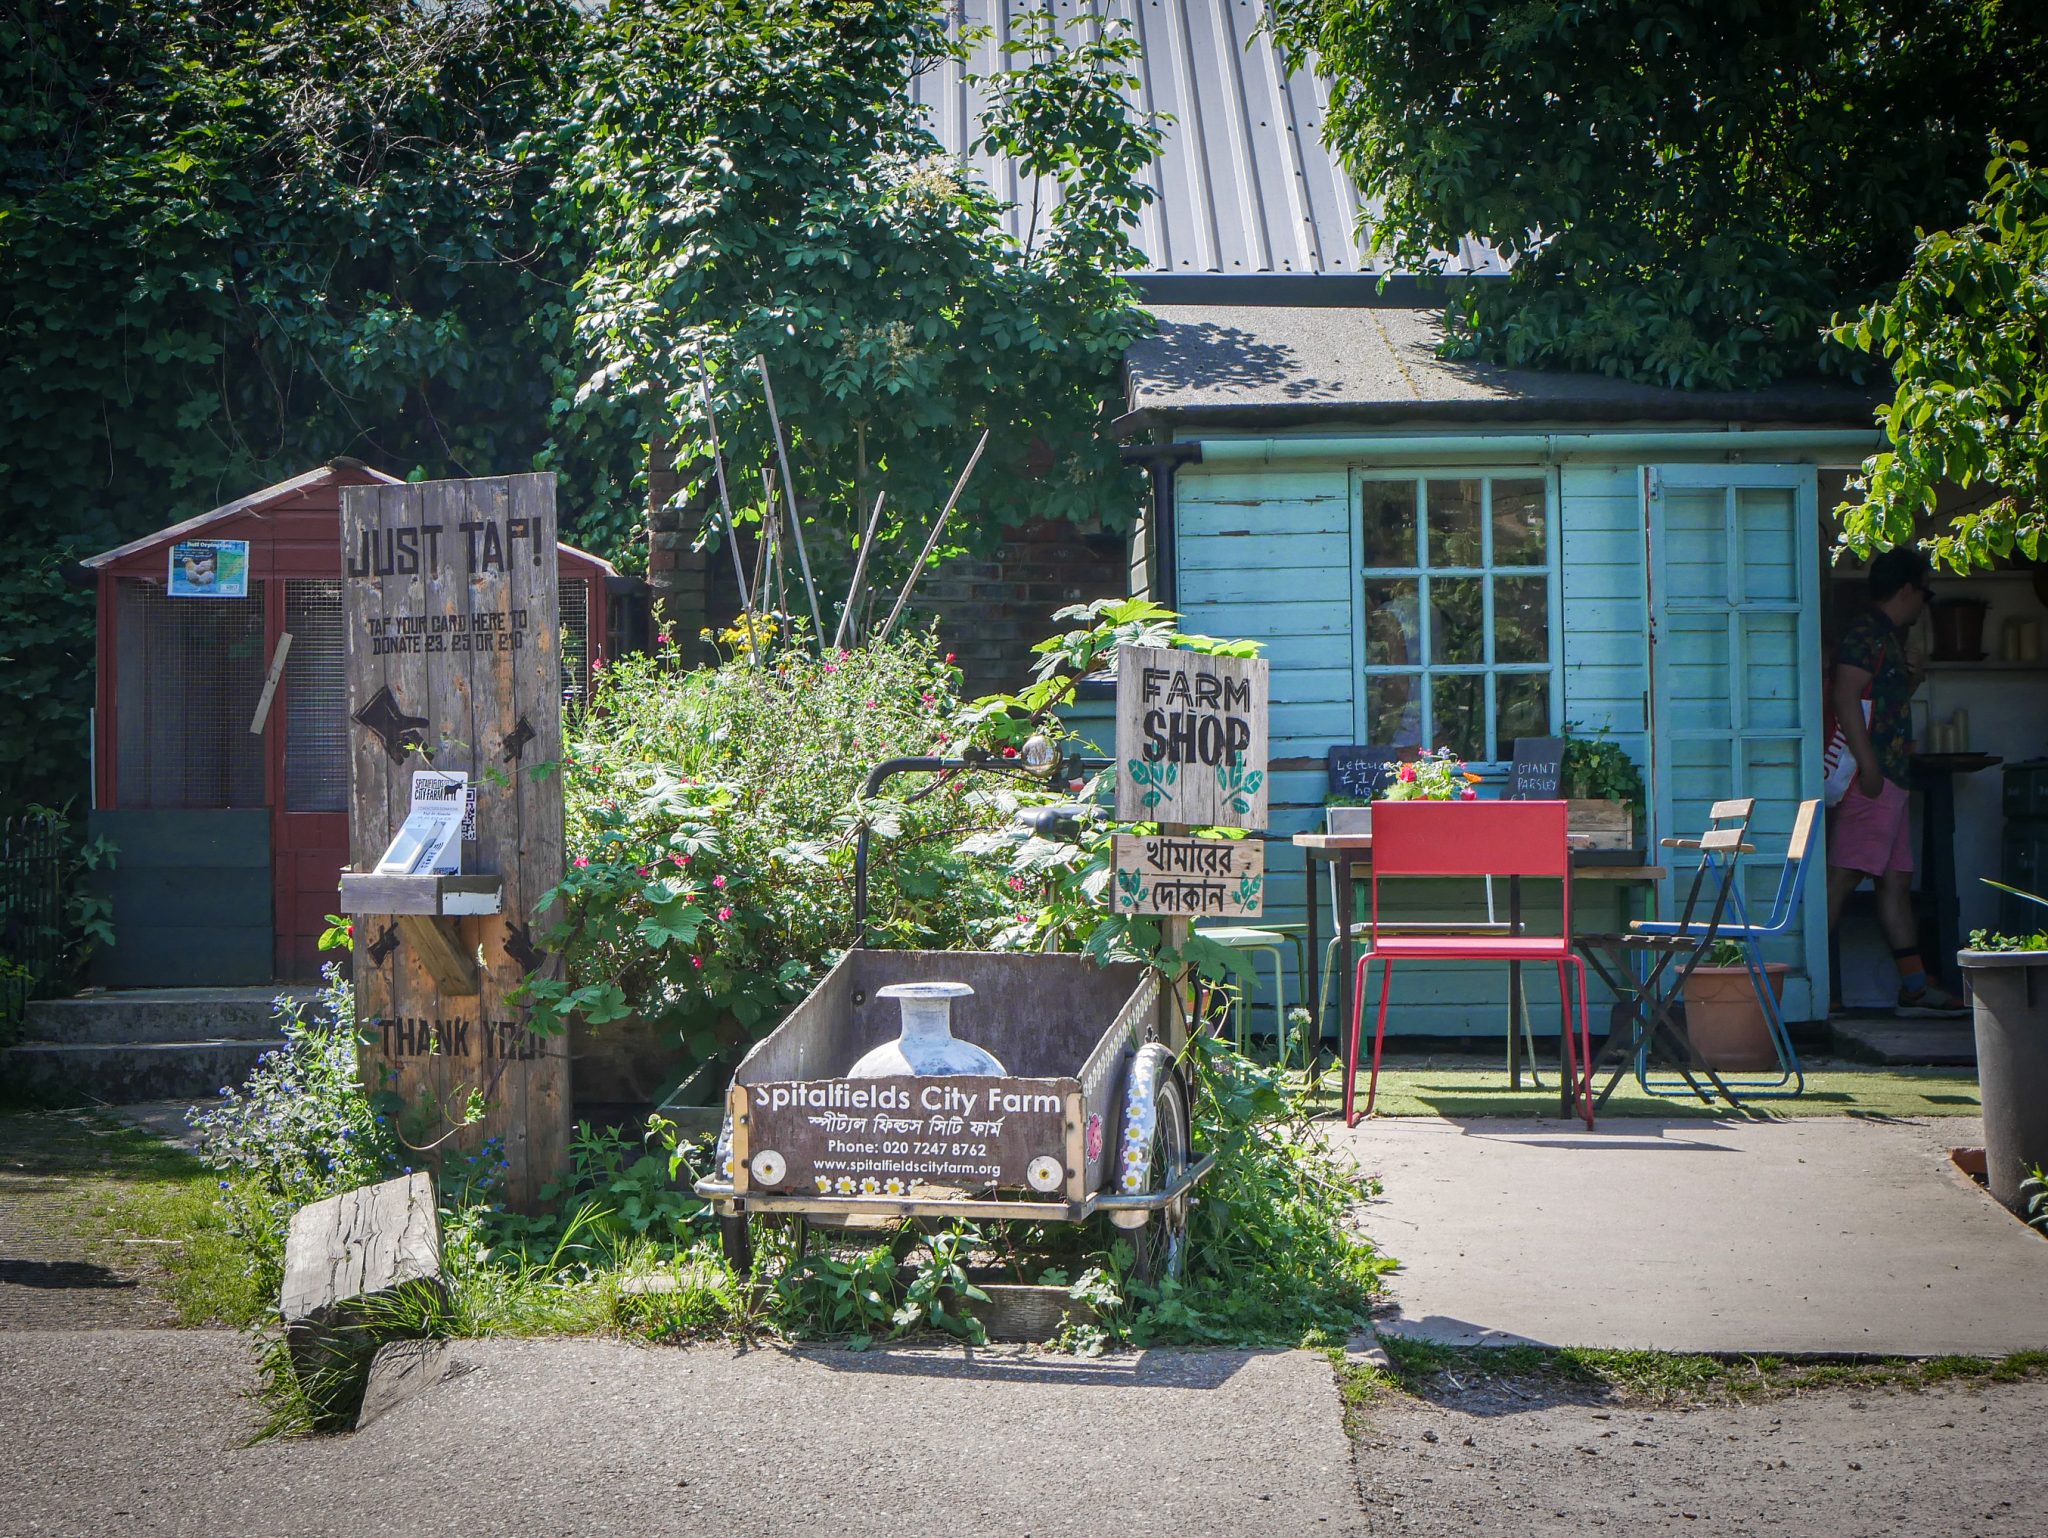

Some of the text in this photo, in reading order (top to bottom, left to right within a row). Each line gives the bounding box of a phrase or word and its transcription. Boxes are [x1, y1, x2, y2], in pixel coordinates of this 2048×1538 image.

[348, 517, 542, 578] JUST TAP!
[368, 610, 527, 636] TAP YOUR CARD HERE TO
[373, 636, 420, 655] DONATE
[452, 634, 471, 651] £5
[476, 633, 493, 651] OR
[1142, 668, 1250, 713] FARM
[1142, 707, 1251, 767] SHOP
[1517, 777, 1556, 791] PARSLEY
[1518, 763, 1557, 775] GIANT
[1147, 838, 1234, 876] খামারের
[1152, 879, 1226, 913] দোকান
[379, 1016, 469, 1057] THANK
[756, 1082, 1061, 1116] Spitalfields City Farm
[928, 1115, 964, 1137] সিটি
[970, 1116, 1005, 1138] ফার্ম
[828, 1140, 986, 1157] Phone: 020 7247 8762
[814, 1159, 1001, 1178] www.spitalfieldscityfarm.org
